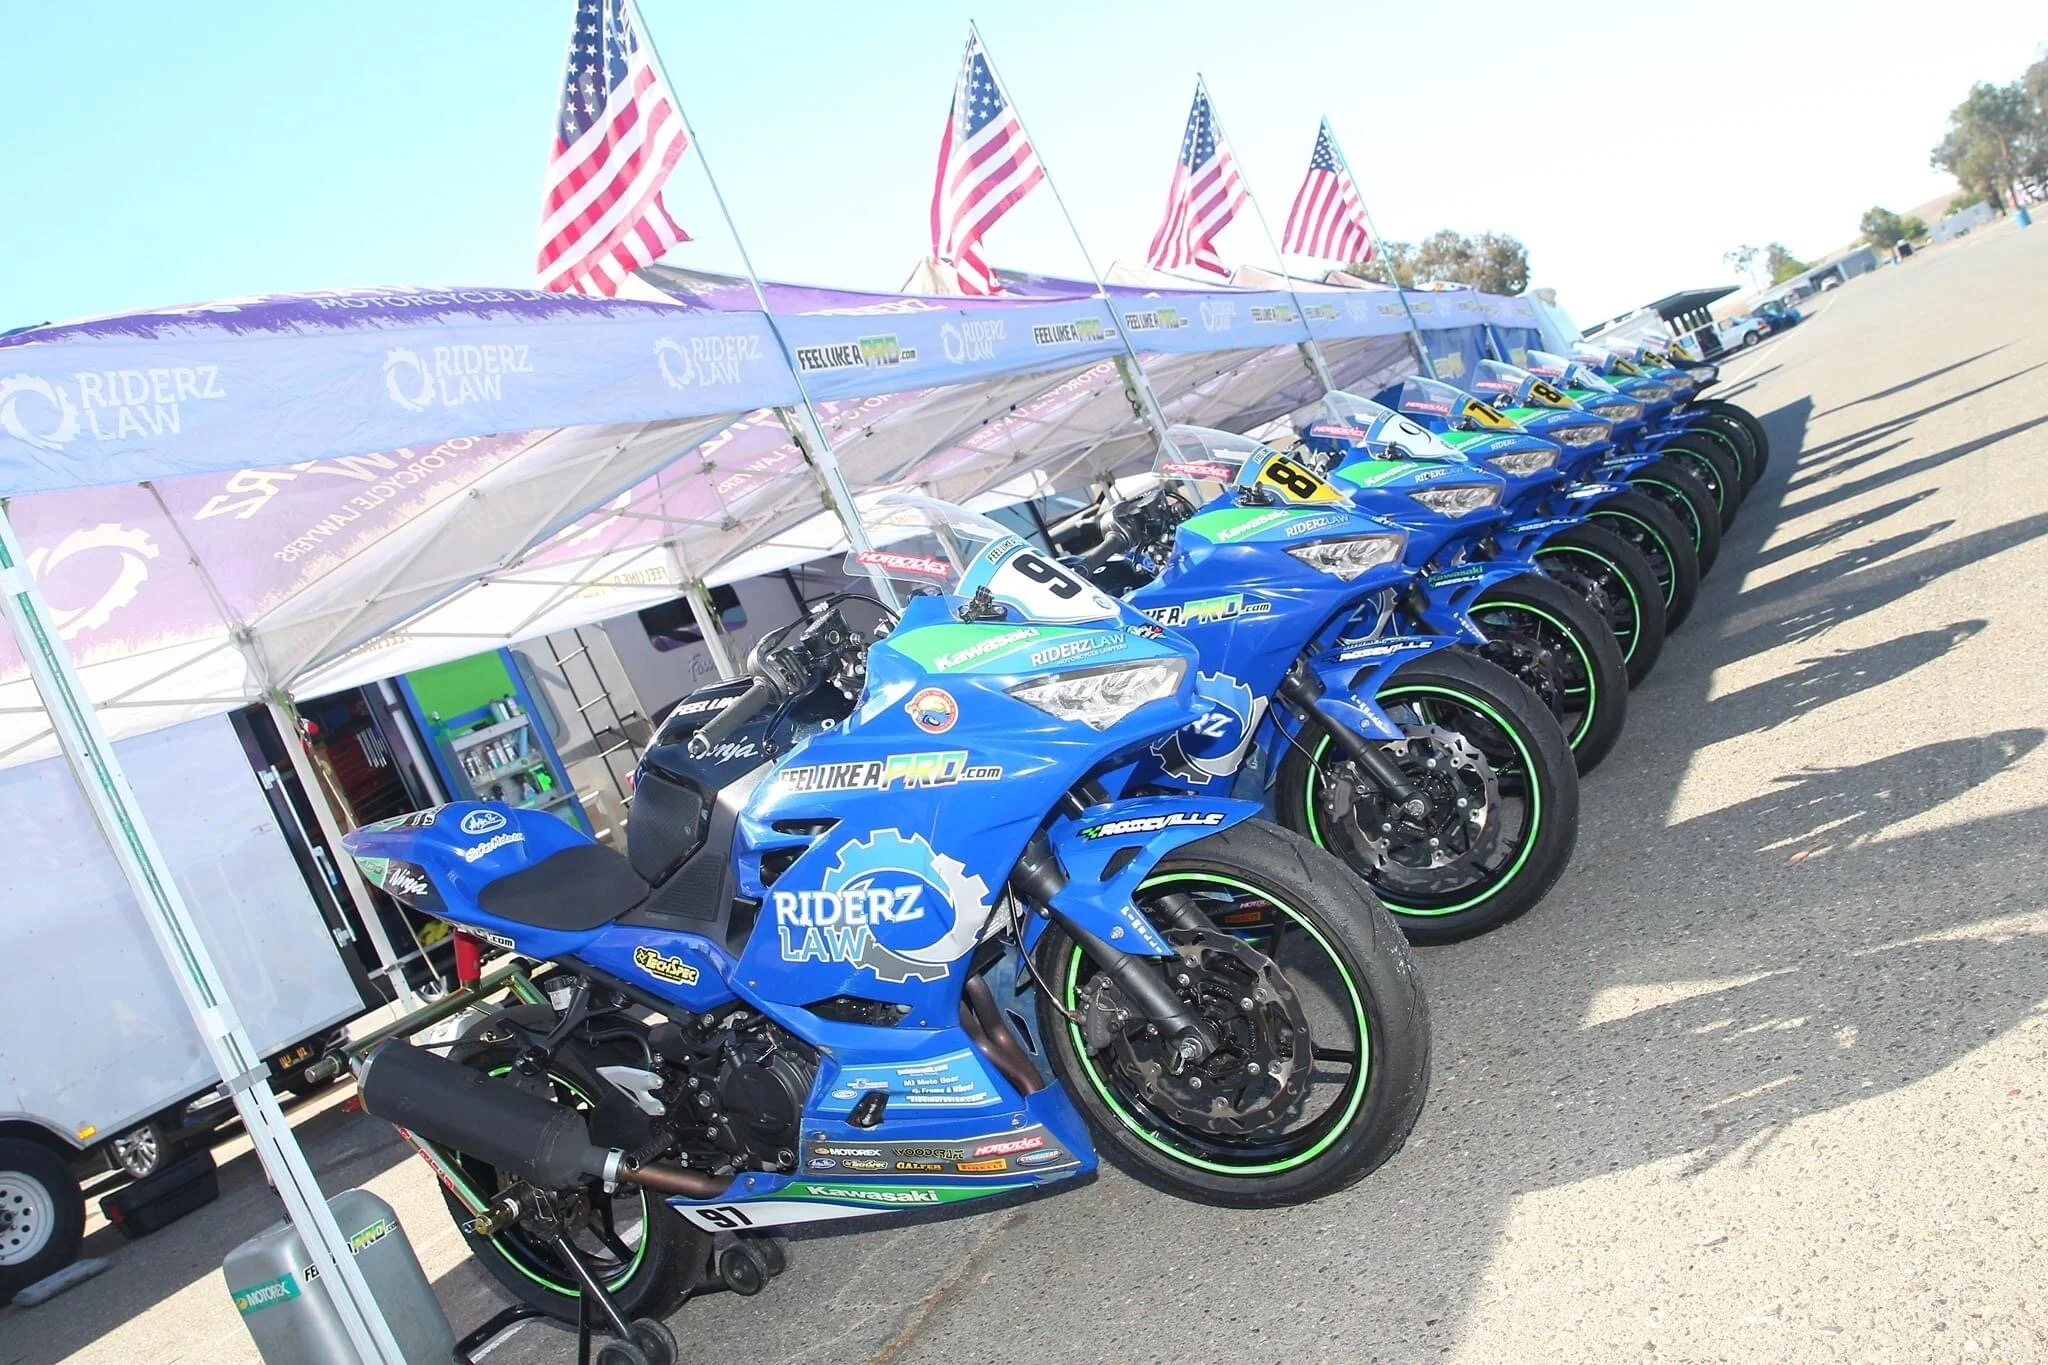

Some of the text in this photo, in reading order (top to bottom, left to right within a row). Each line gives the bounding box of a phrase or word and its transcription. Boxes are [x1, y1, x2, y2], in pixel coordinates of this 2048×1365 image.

[312, 290, 515, 310] MOTORCYCLE
[961, 320, 1007, 341] RIDERZ
[433, 345, 534, 376] RIDERZ
[690, 335, 763, 361] RIDERZ
[75, 365, 226, 410] RIDERZ
[697, 361, 742, 387] LAW
[438, 374, 502, 407] LAW
[84, 403, 182, 441] LAW
[1266, 456, 1324, 499] 8
[933, 626, 1041, 672] Kawasaki
[816, 764, 863, 790] LIKE
[863, 762, 881, 786] A
[389, 867, 429, 896] Ninja
[774, 884, 925, 928] RIDERZ
[777, 924, 869, 963] LAW
[829, 1147, 882, 1157] MOTOREX
[805, 1185, 939, 1202] Kawasaki
[695, 1205, 753, 1228] 97
[246, 1281, 292, 1307] MOTOREX
